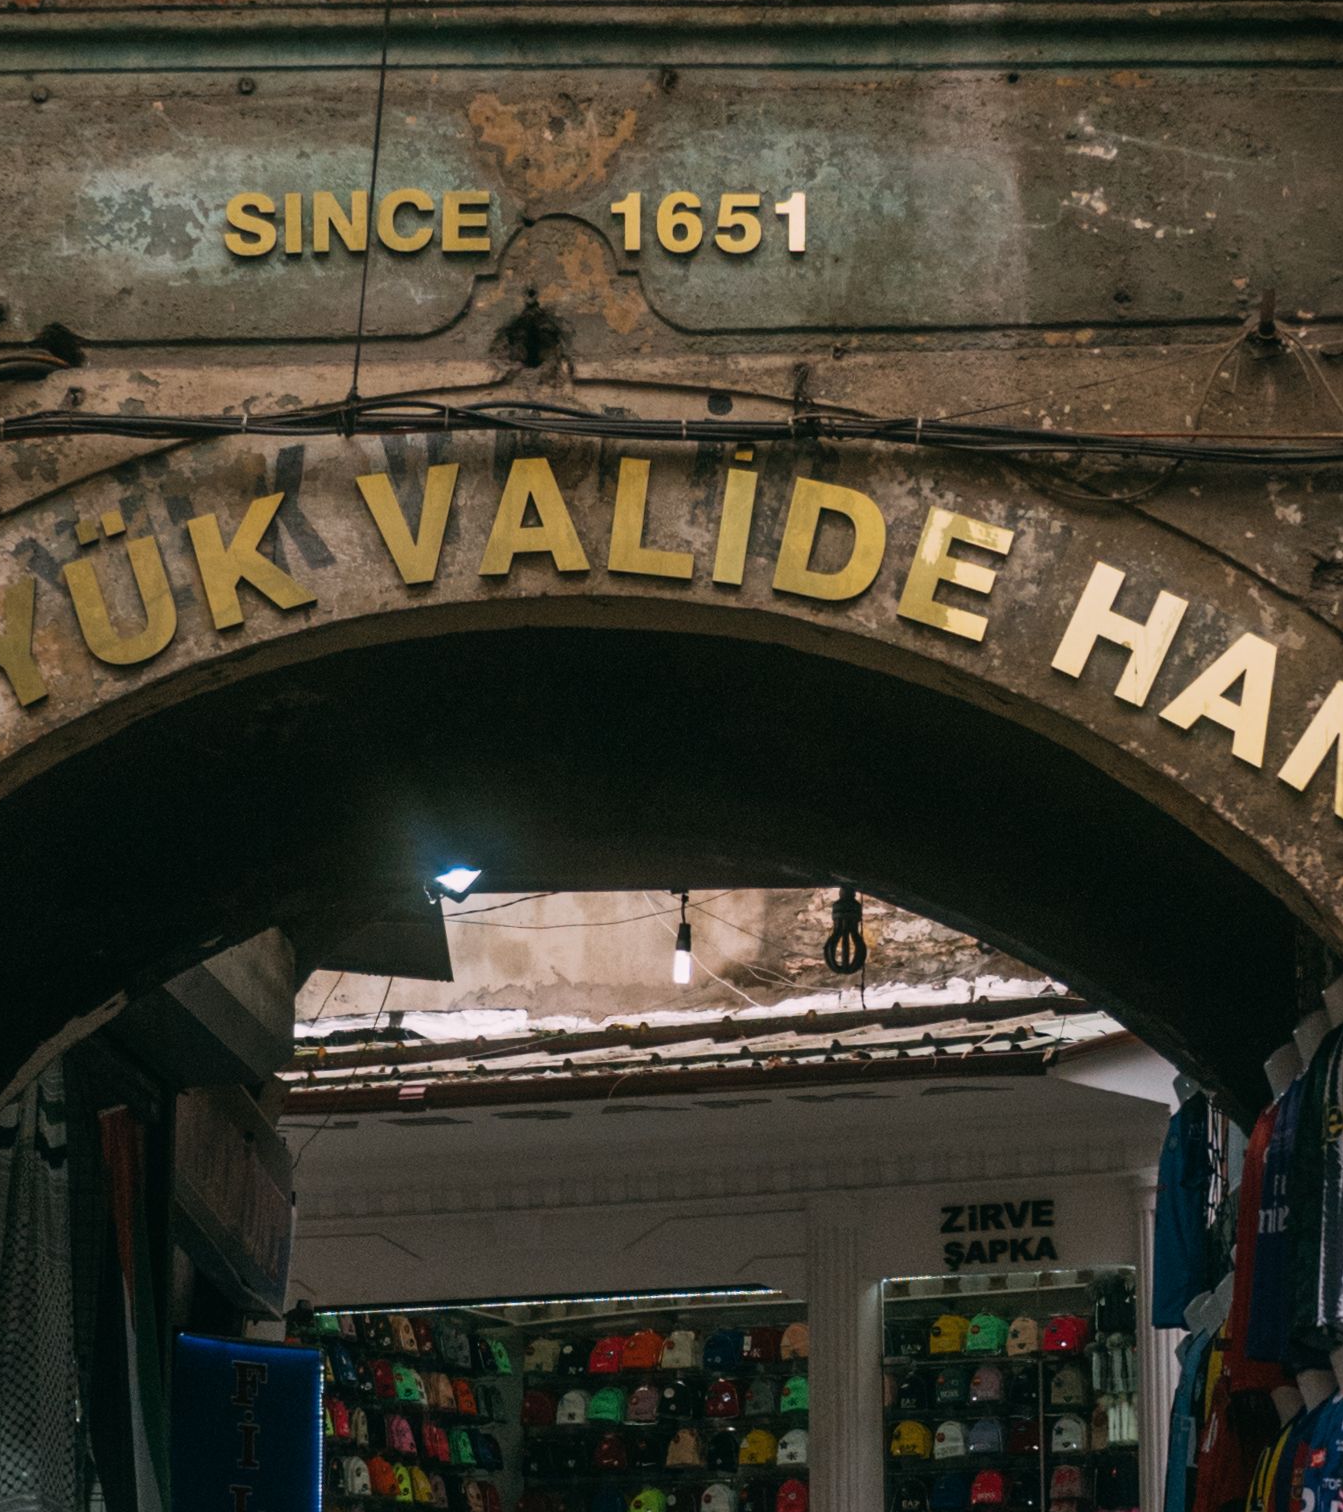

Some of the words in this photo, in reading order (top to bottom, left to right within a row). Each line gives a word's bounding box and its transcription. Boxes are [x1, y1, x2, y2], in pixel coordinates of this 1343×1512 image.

[223, 189, 492, 258] SINCE
[607, 192, 810, 255] 1651
[356, 448, 1015, 645] VALİDE
[944, 1236, 1058, 1272] ŞAPKA
